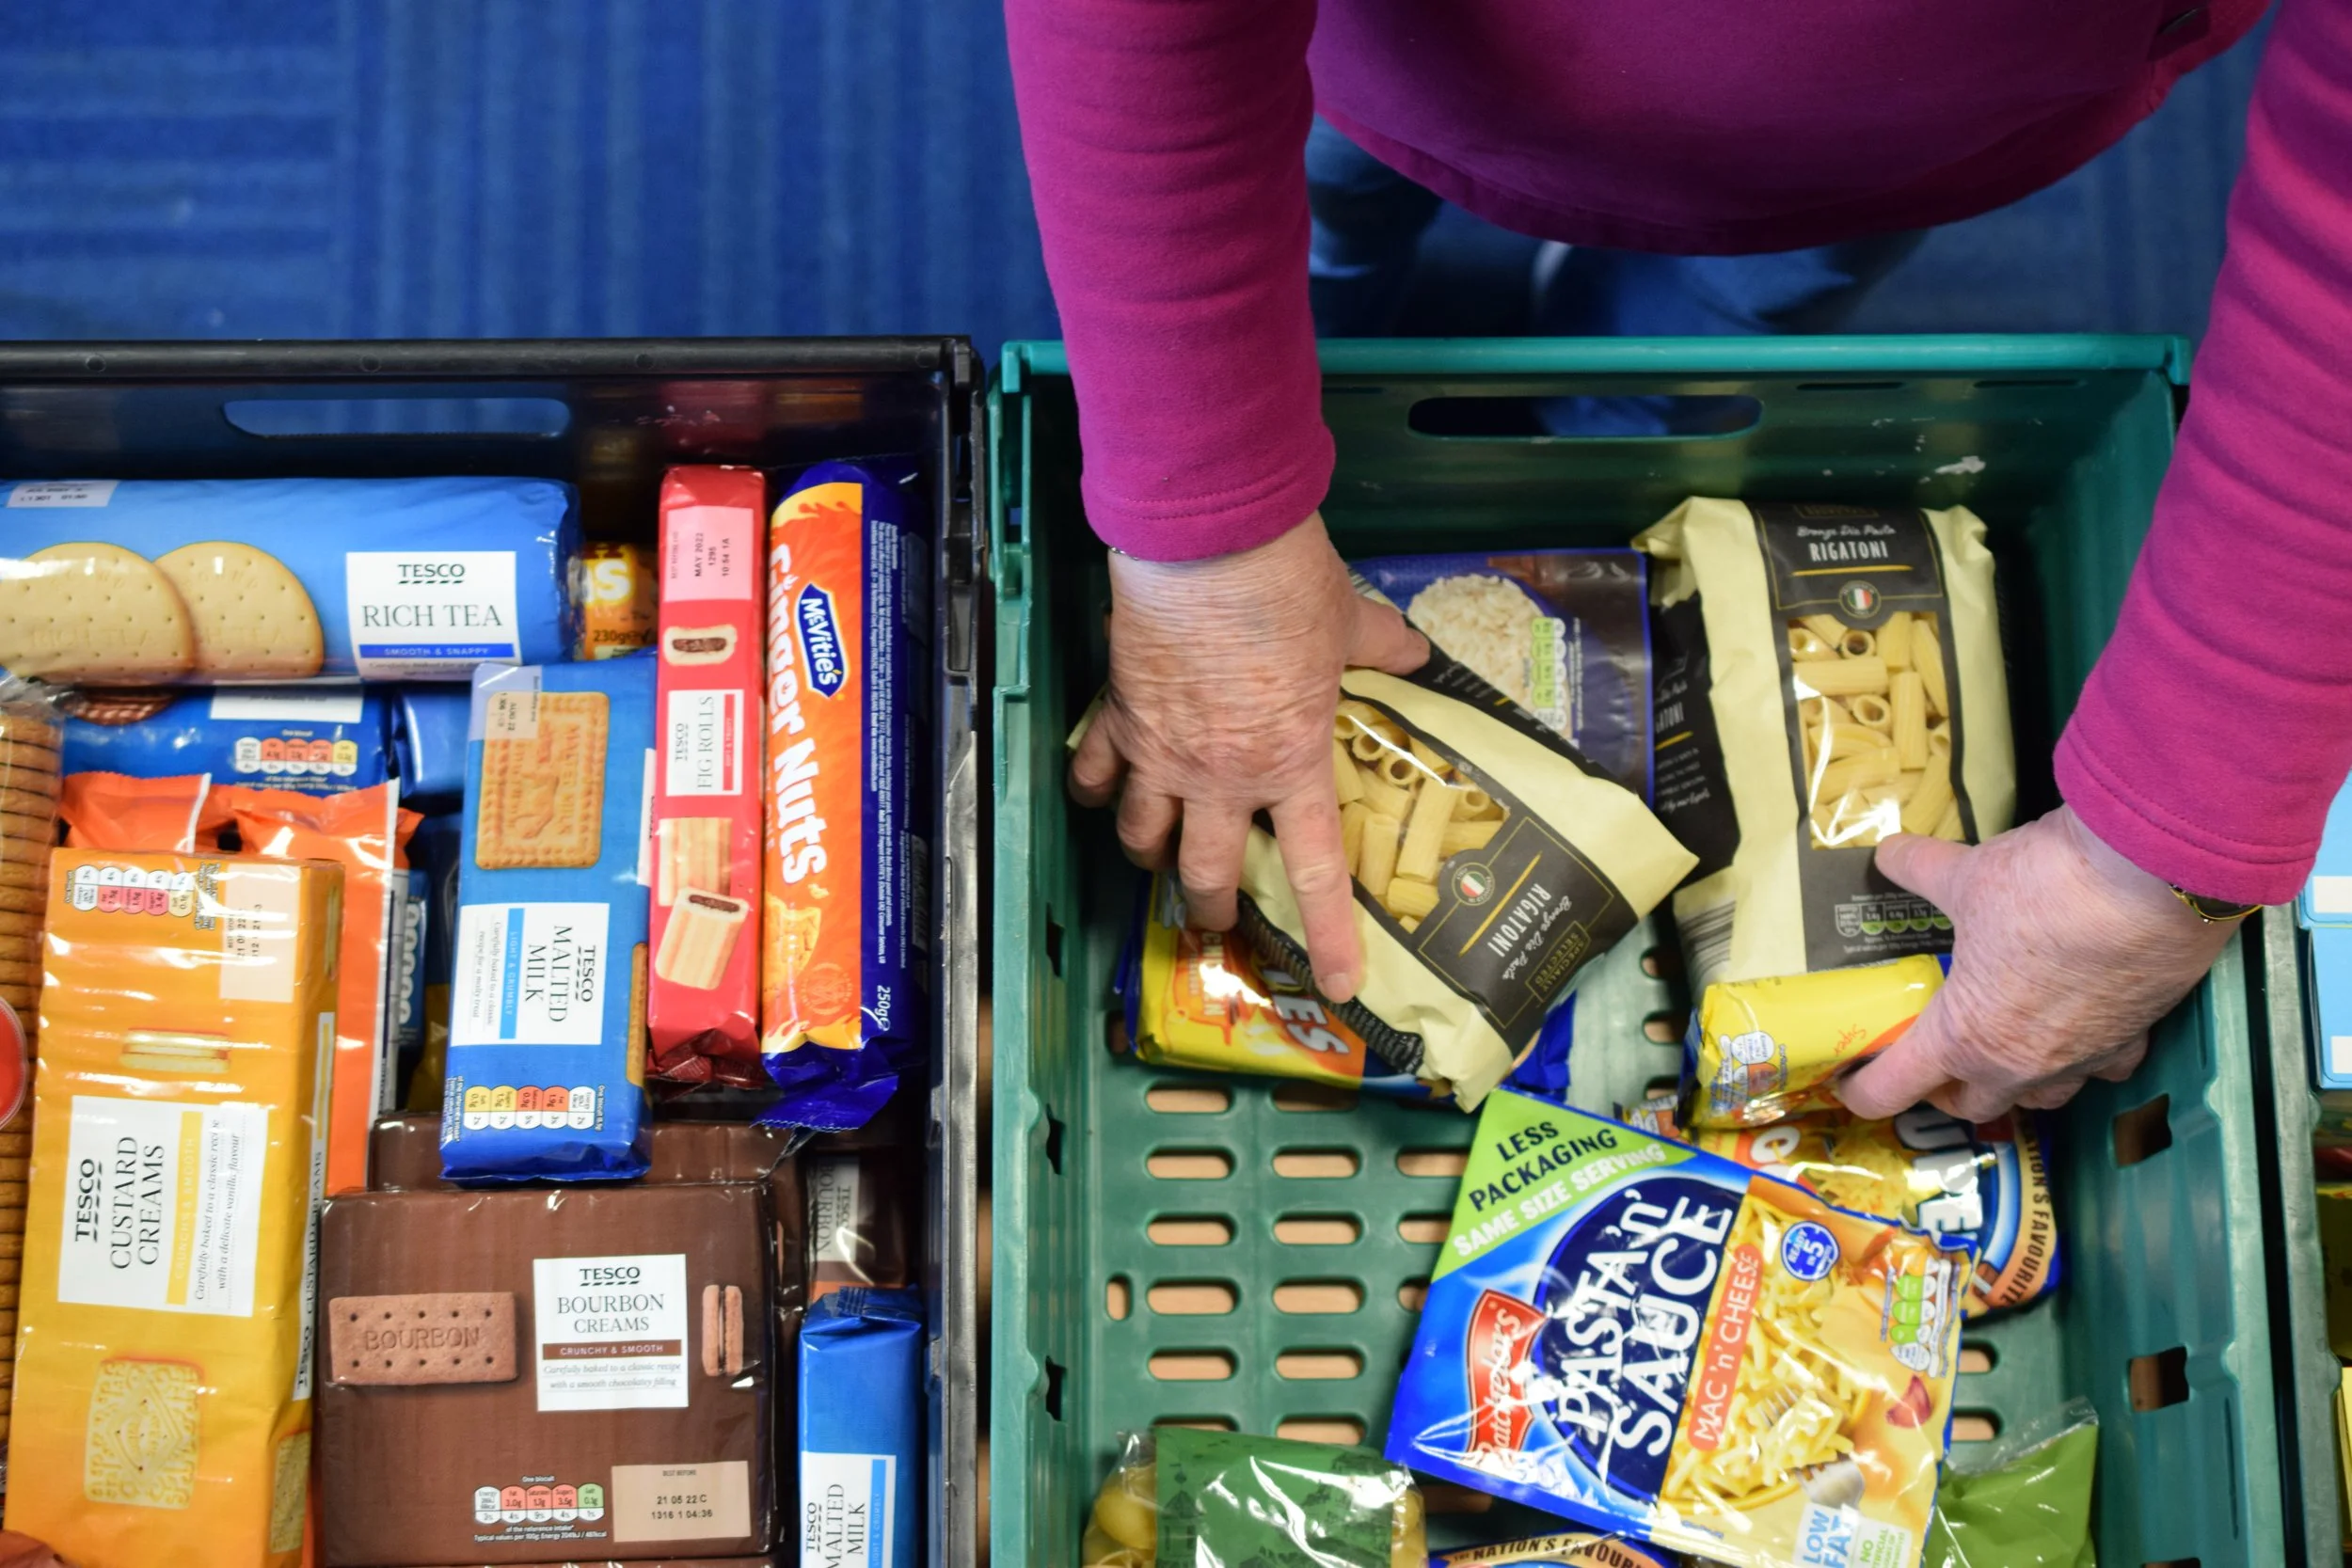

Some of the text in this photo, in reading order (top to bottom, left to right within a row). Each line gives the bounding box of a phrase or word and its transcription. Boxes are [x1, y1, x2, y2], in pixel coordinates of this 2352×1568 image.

[723, 538, 730, 548] 1A
[1797, 526, 1837, 541] Bronze
[1808, 541, 1888, 562] RIGATONI
[397, 564, 465, 578] TESCO
[708, 546, 717, 566] 1295
[361, 605, 502, 627] RICH TEA
[436, 647, 442, 656] &
[801, 597, 840, 686] McVitie's
[675, 723, 684, 762] TESCO
[697, 696, 714, 788] FIG ROLLS
[771, 737, 830, 885] Nuts
[1487, 883, 1551, 958] RIGATONI
[1502, 895, 1573, 981] Bronze Die Pasta
[477, 931, 485, 954] recipe
[492, 922, 501, 956] Carefully
[475, 956, 485, 968] for
[490, 958, 500, 982] baked
[526, 943, 547, 1002] MILK
[549, 925, 573, 1022] MALTED
[581, 945, 596, 1003] TESCO
[1535, 935, 1579, 985] SELECTED
[1542, 941, 1584, 990] SPECIALLY
[474, 975, 483, 997] malty
[506, 973, 516, 1016] CRUMBLY
[877, 986, 891, 1021] 250g
[1833, 1023, 1867, 1057] Super
[496, 1093, 505, 1107] 1.5g
[522, 1092, 531, 1108] 0.9g
[548, 1094, 556, 1108] 1.9g
[229, 1132, 243, 1171] flavour
[1495, 1116, 1561, 1164] LESS
[183, 1138, 196, 1194] SMOOTH
[206, 1154, 218, 1190] classic
[1468, 1127, 1619, 1212] PACKAGING
[74, 1158, 95, 1242] TESCO
[108, 1136, 140, 1270] CUSTARD
[135, 1144, 167, 1266] CREAMS
[205, 1202, 215, 1212] to
[818, 1165, 834, 1253] BOURBON
[1451, 1142, 1668, 1259] SAME SIZE SERVING
[200, 1216, 214, 1248] baked
[219, 1211, 232, 1254] delicate
[1787, 1227, 1807, 1263] READY
[1802, 1238, 1826, 1259] 5
[195, 1251, 211, 1300] Carefully
[580, 1266, 641, 1280] TESCO
[2001, 1211, 2050, 1306] FAVOURITE
[216, 1266, 228, 1290] with
[296, 1325, 311, 1387] TESCO
[305, 1231, 317, 1314] CUSTARD
[557, 1293, 664, 1314] BOURBON
[364, 1326, 481, 1353] BOURBON
[574, 1317, 649, 1333] CREAMS
[1554, 1251, 1649, 1432] PASTA
[1613, 1195, 1735, 1456] SAUCE
[560, 1346, 608, 1355] CRUNCHY
[621, 1345, 663, 1354] SMOOTH
[1694, 1380, 1727, 1442] MAC
[1720, 1252, 1759, 1342] CHEESE
[544, 1365, 581, 1375] Carefully
[583, 1364, 608, 1372] baked
[628, 1363, 656, 1371] classic
[657, 1363, 681, 1372] recipe
[550, 1380, 567, 1388] with
[577, 1380, 607, 1388] smooth
[653, 1378, 676, 1387] filling
[652, 1511, 674, 1519] 1316
[686, 1510, 713, 1518] 04:36
[657, 1494, 707, 1505] 21 05 22 C
[805, 1502, 817, 1552] TESCO
[824, 1483, 844, 1568] MALTED
[847, 1502, 866, 1555] MILK
[1803, 1510, 1830, 1564] LOW
[1473, 1538, 1557, 1560] NATION'S
[1859, 1539, 1875, 1563] NO
